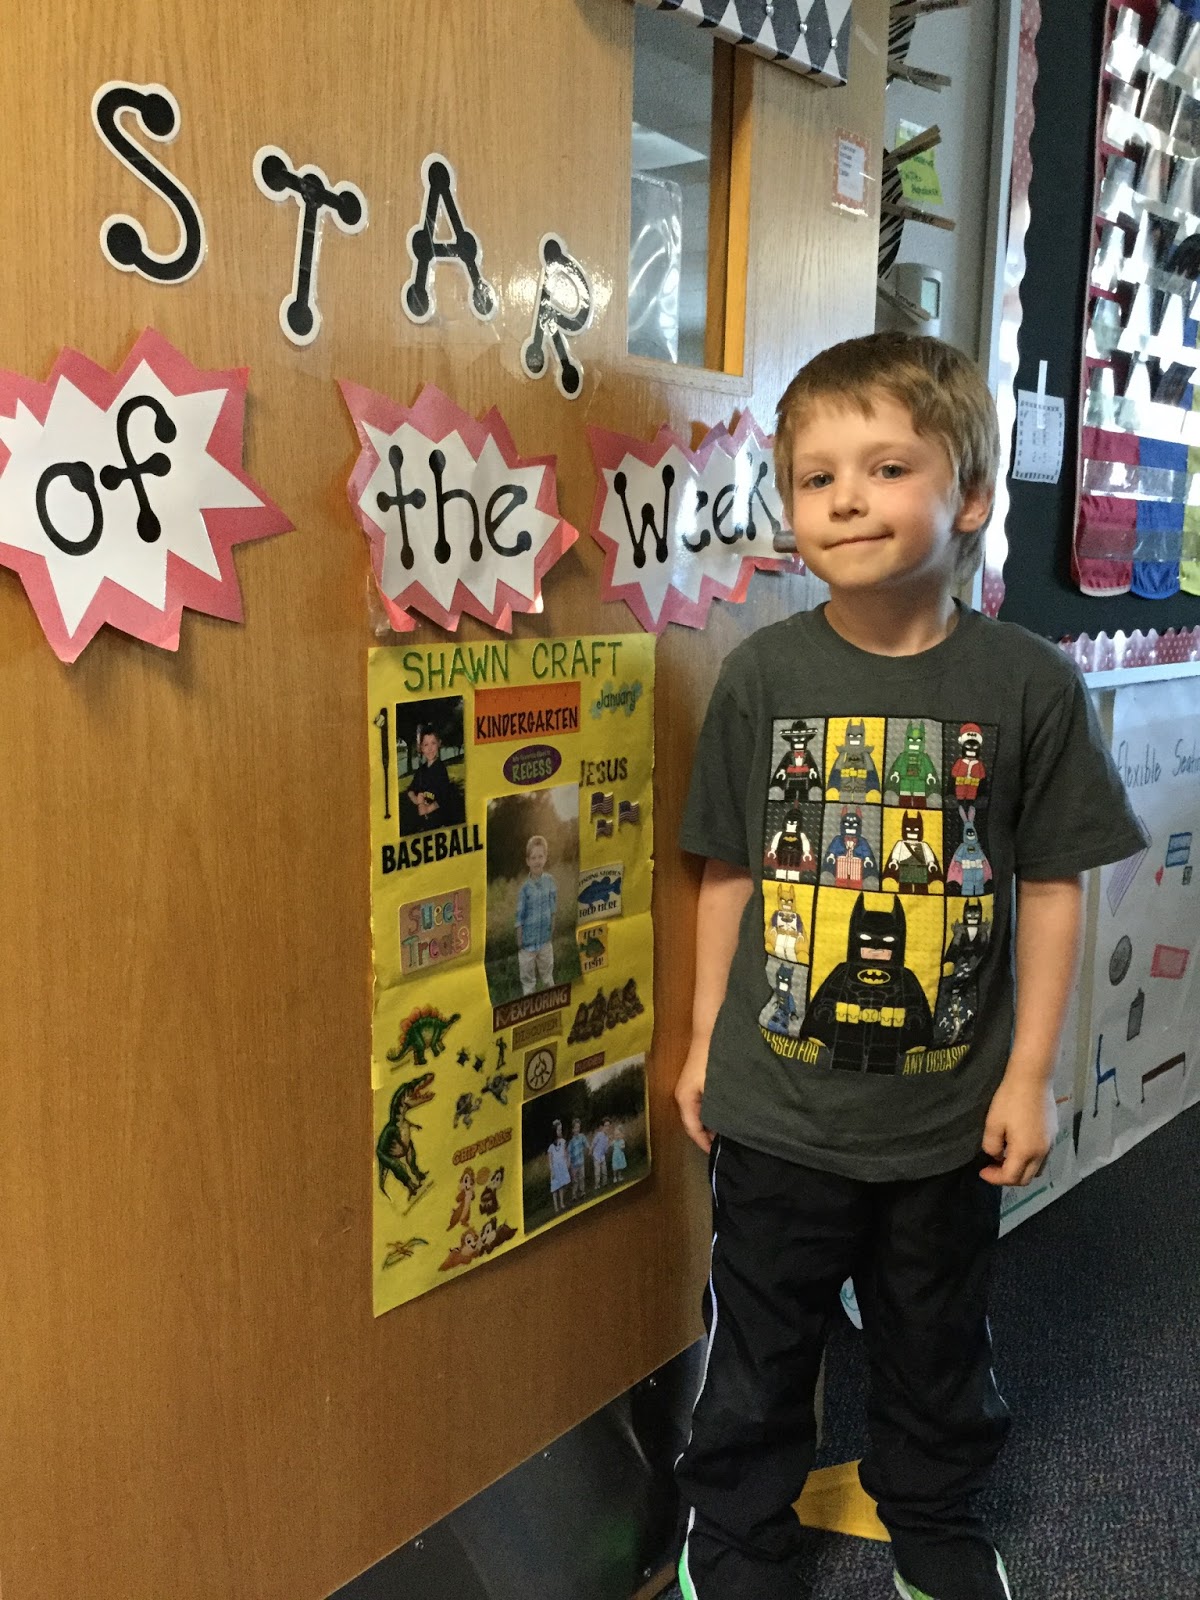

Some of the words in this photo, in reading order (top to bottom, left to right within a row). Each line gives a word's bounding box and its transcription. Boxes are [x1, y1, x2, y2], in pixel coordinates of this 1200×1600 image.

[36, 395, 177, 556] of
[377, 444, 532, 570] the
[403, 643, 509, 692] SHAWN
[532, 640, 623, 679] CRAFT
[596, 689, 637, 712] January
[476, 706, 579, 740] KINDERGARTEN
[512, 757, 553, 782] RECESS
[578, 757, 628, 788] JESUS
[382, 824, 484, 875] BASEBALL
[509, 987, 569, 1019] EXPLORING
[797, 1041, 820, 1065] FOR
[902, 1053, 925, 1076] ANY
